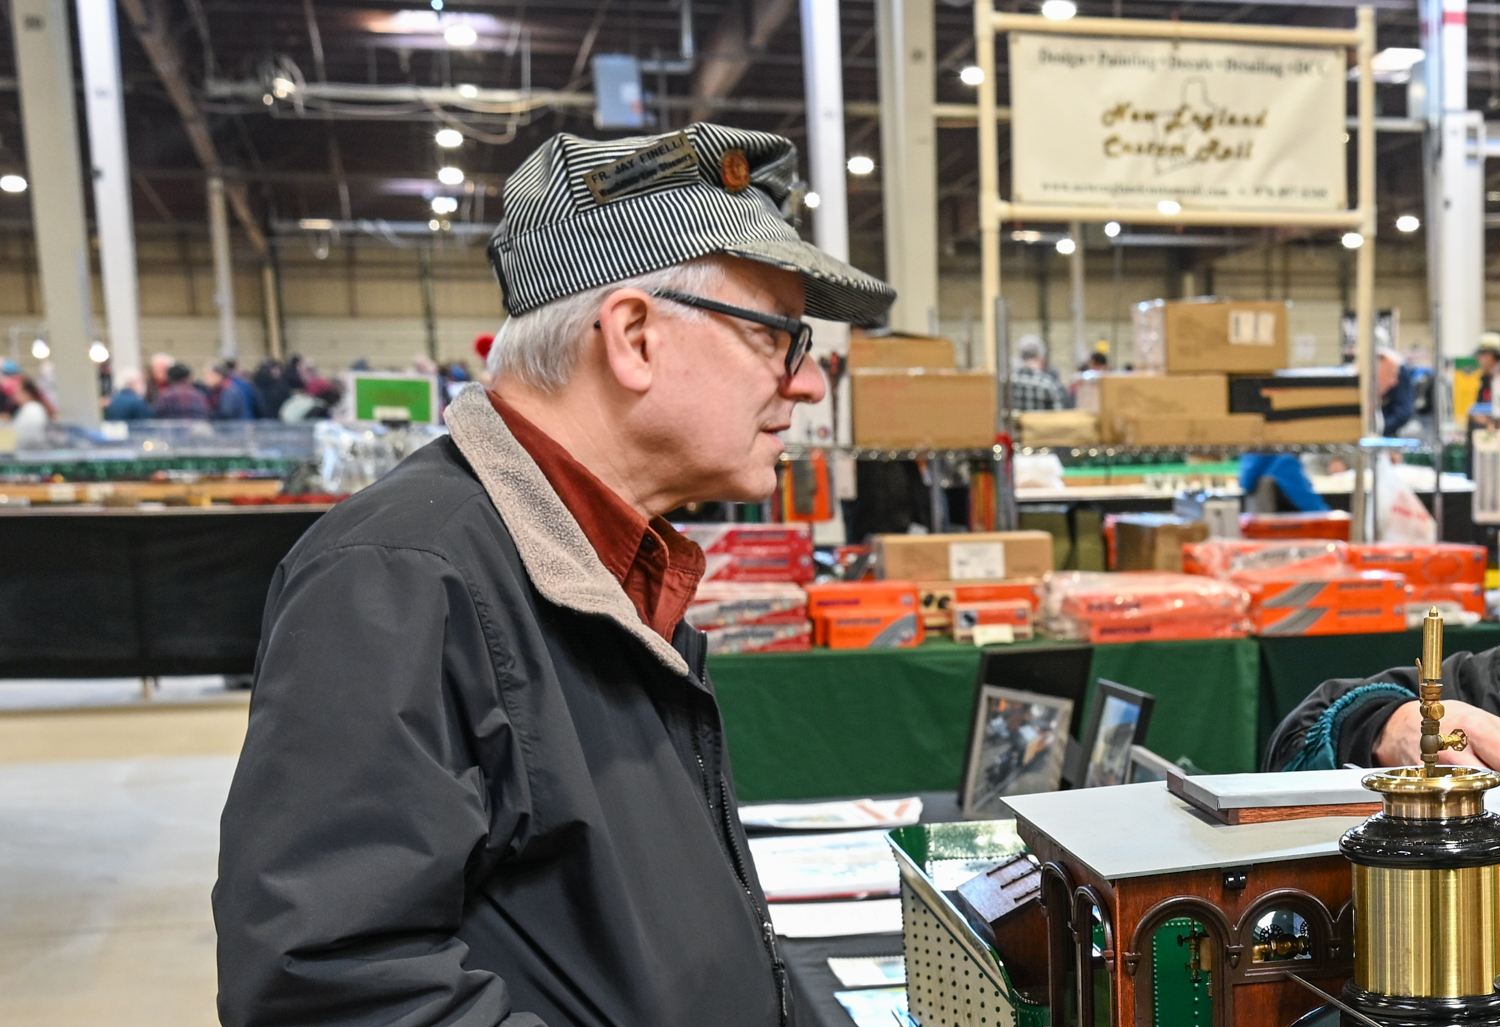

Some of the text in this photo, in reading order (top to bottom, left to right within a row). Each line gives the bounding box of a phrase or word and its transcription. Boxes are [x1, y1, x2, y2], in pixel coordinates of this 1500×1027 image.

[1038, 50, 1086, 69] Design
[1098, 51, 1156, 72] Painting
[1102, 102, 1268, 134] New England
[614, 158, 635, 174] JAY
[639, 136, 685, 163] FINELLI
[1103, 136, 1186, 158] Custom
